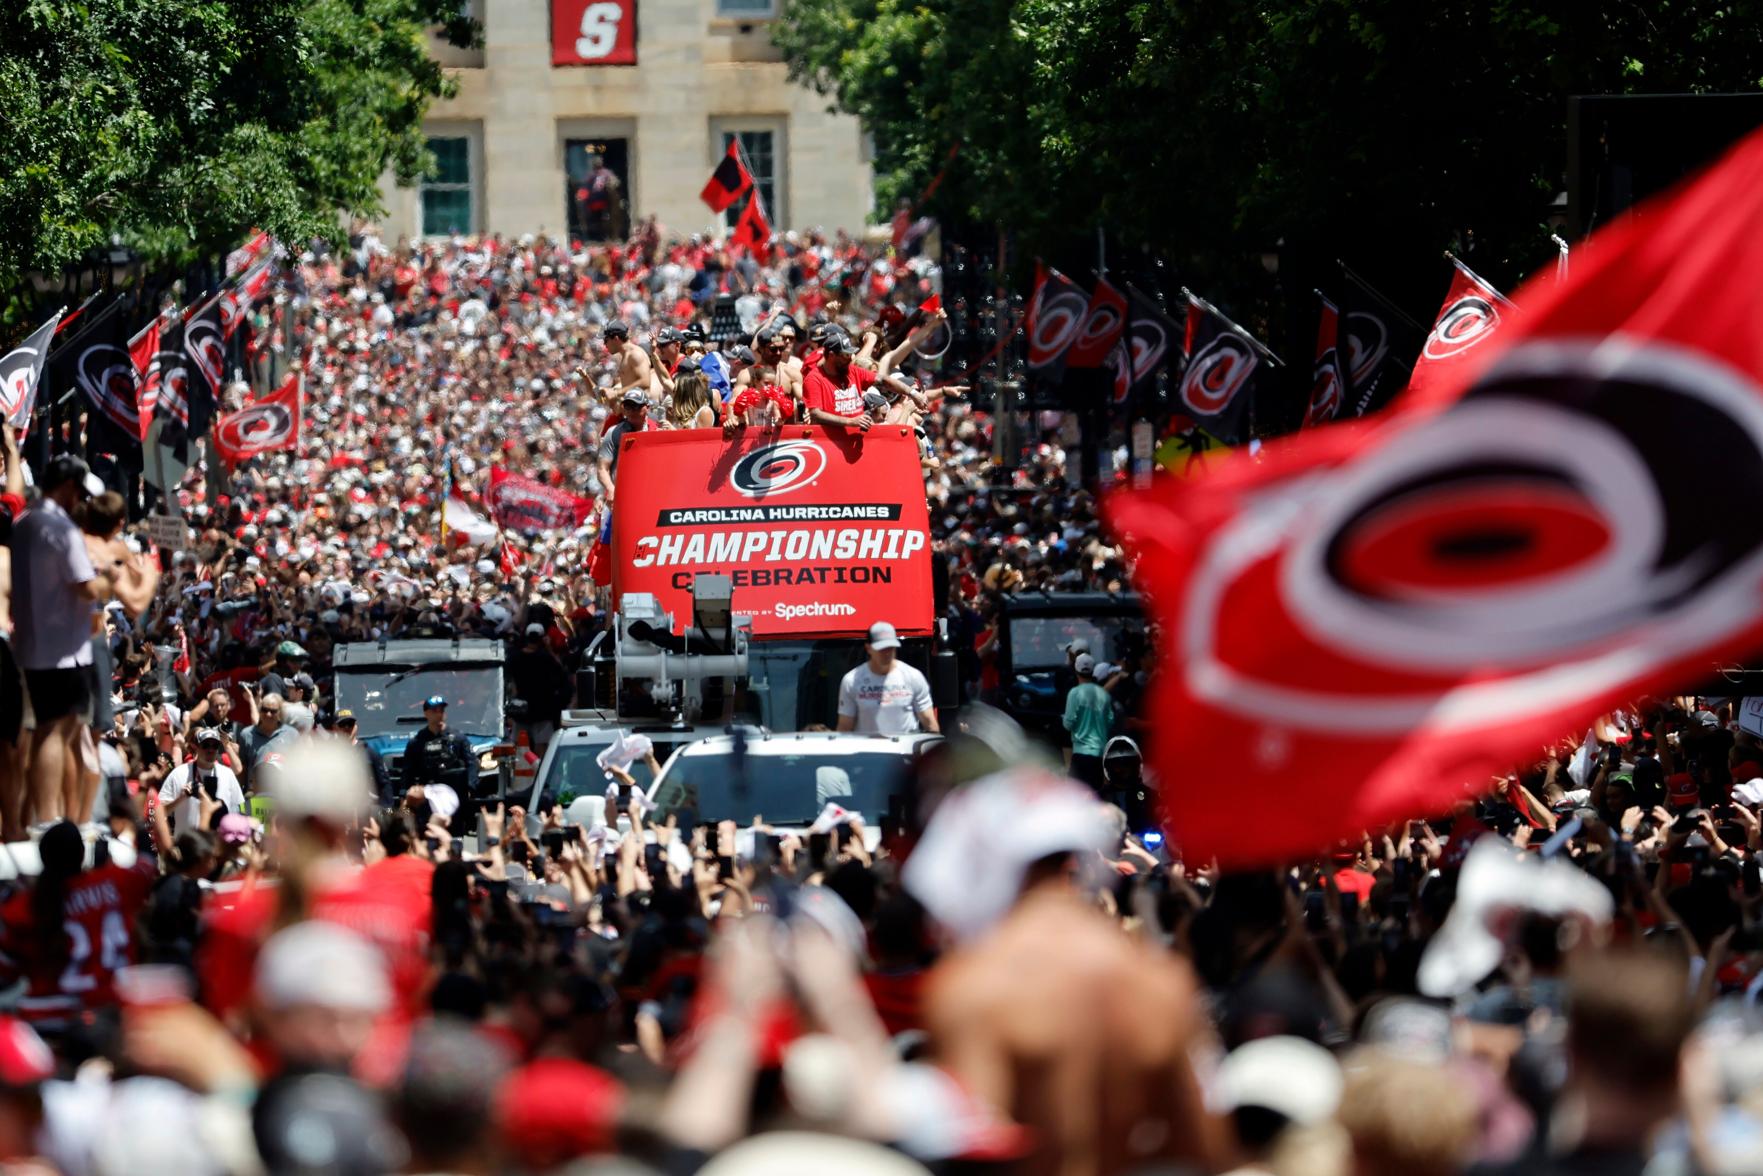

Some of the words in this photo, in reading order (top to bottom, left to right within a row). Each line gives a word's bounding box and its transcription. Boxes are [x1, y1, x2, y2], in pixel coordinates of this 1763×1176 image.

[575, 2, 623, 59] S
[669, 508, 766, 524] CAROLINA
[769, 505, 890, 521] HURRICANES
[632, 528, 926, 568] CHAMPIONSHIP
[671, 566, 892, 590] CEBRATION
[774, 601, 852, 621] Spectrum
